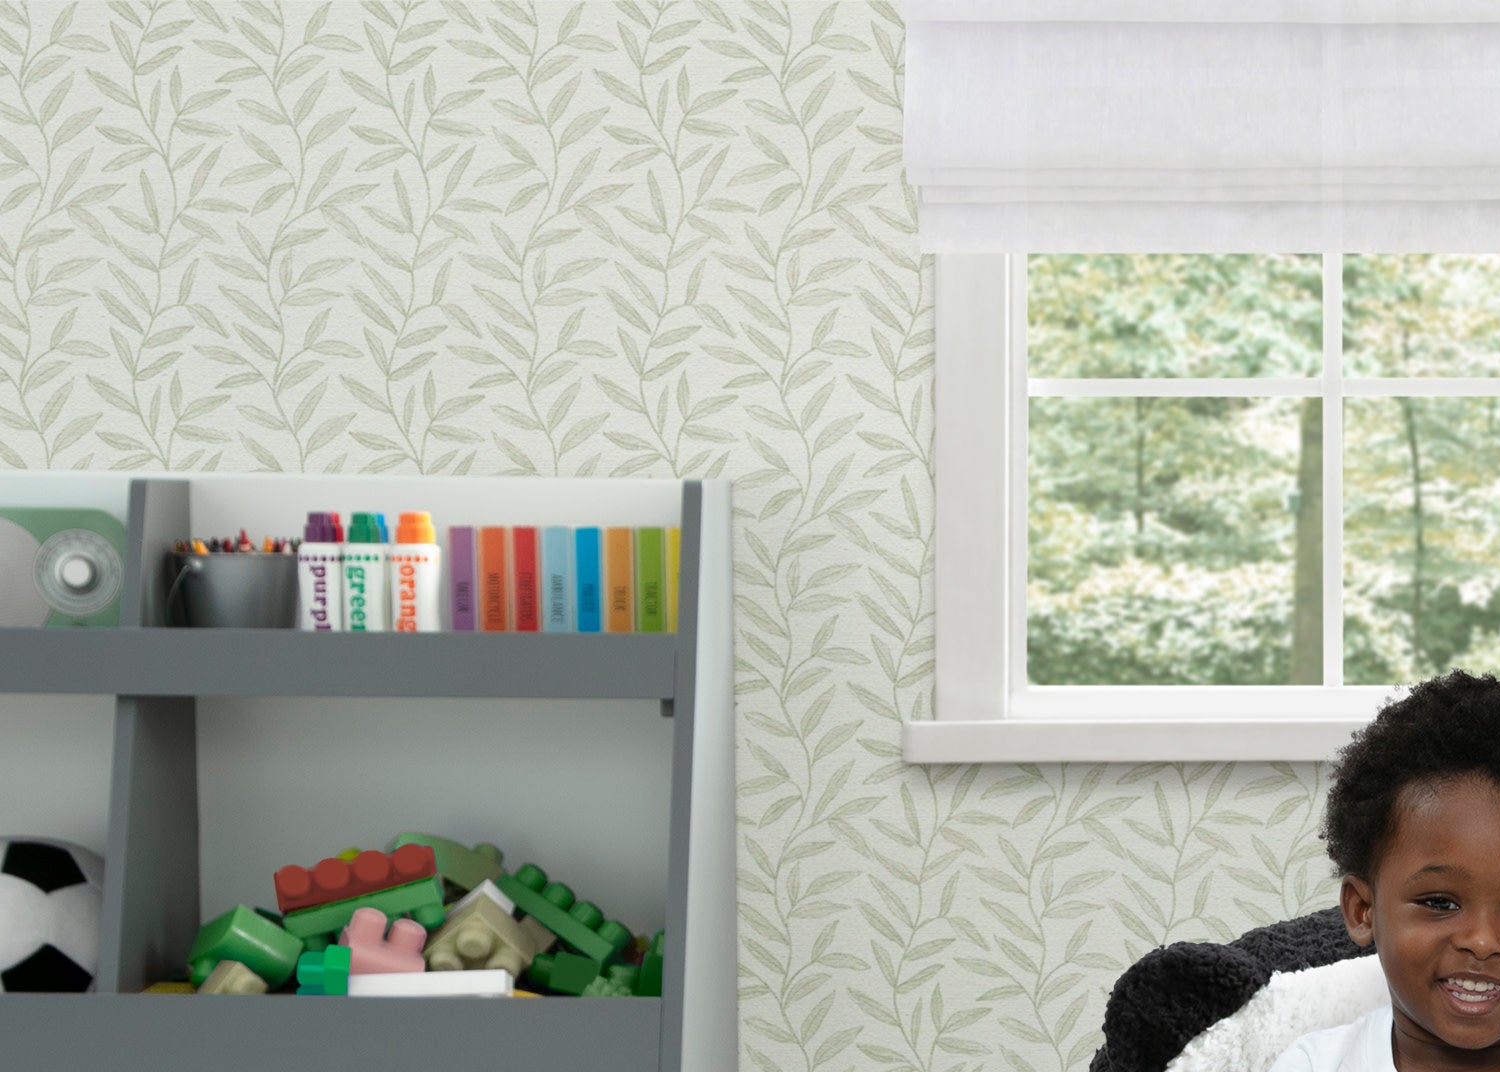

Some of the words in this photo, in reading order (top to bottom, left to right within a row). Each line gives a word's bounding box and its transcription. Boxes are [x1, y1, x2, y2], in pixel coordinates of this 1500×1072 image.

[310, 566, 331, 631] purpl
[396, 564, 417, 632] orang
[487, 572, 500, 622] MOTORCYCLE
[551, 574, 564, 623] AMBULANCE
[613, 586, 627, 611] TRUCK
[644, 582, 658, 616] TRACTOR
